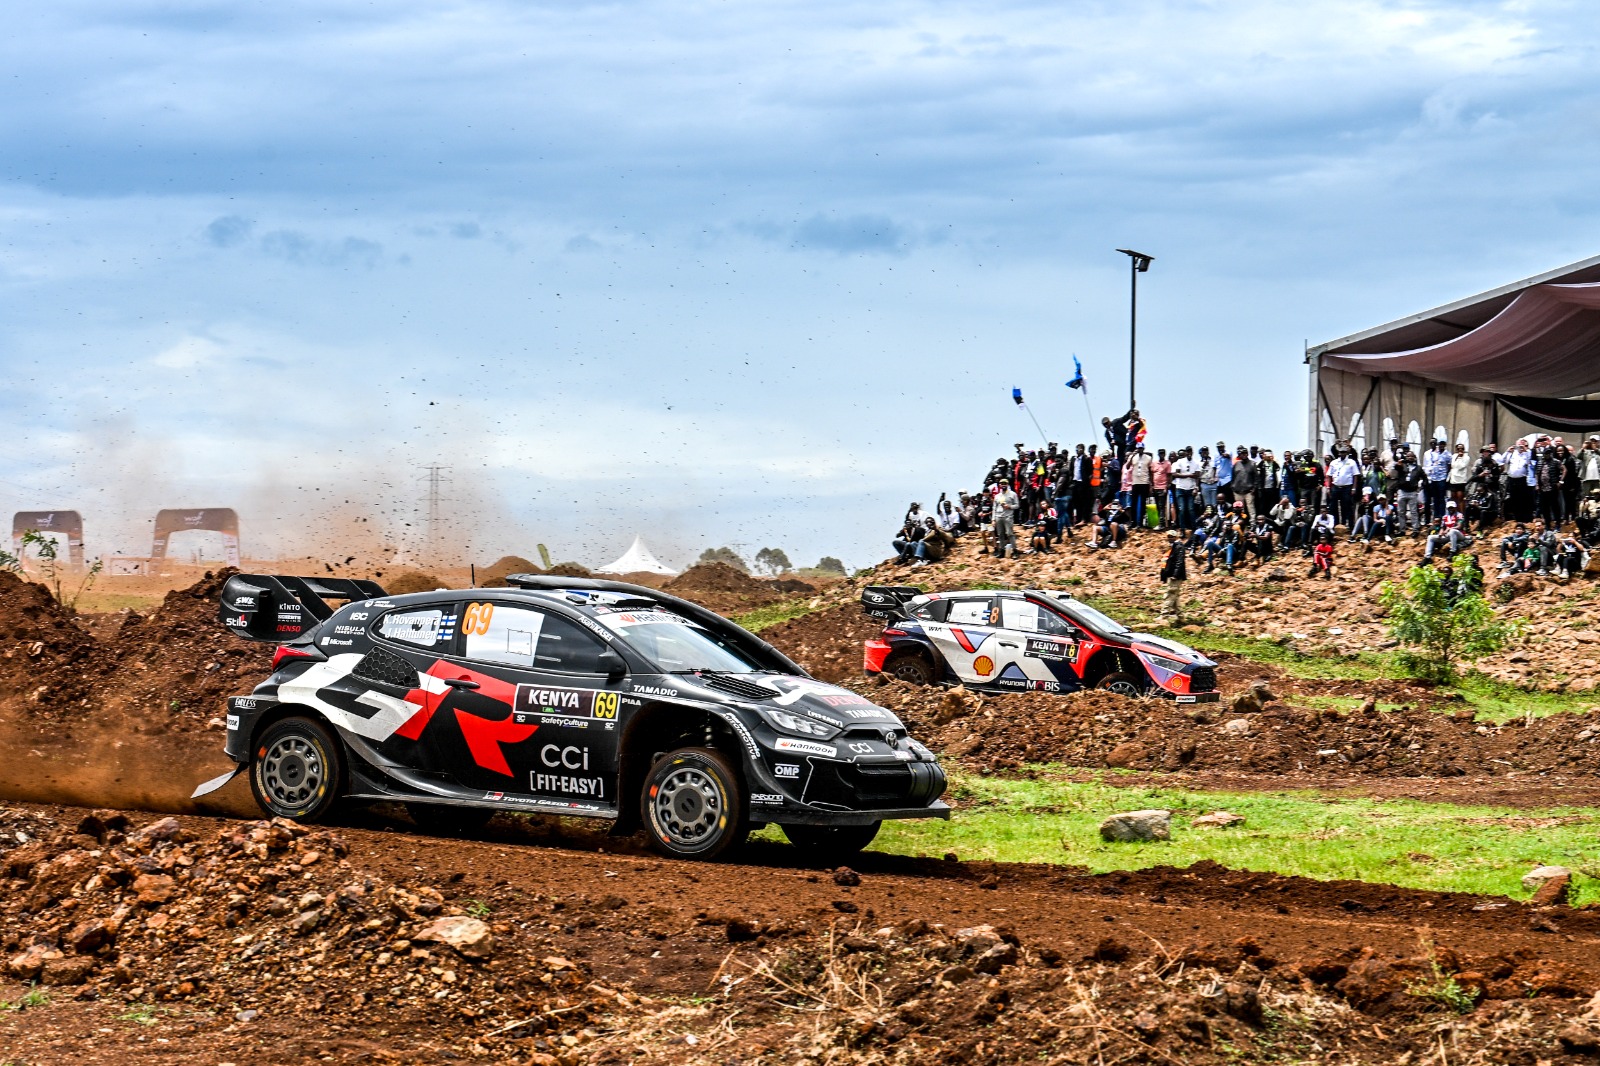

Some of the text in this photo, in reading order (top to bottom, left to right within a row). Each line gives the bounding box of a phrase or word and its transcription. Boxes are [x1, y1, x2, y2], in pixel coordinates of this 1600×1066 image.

[226, 614, 247, 627] Stilo
[462, 602, 493, 635] 69
[990, 607, 999, 623] 8
[1032, 641, 1059, 652] KENYA
[1068, 644, 1075, 657] 8
[633, 684, 678, 697] TAMADIC
[1026, 680, 1060, 692] MOBIS
[528, 689, 579, 708] KENYA
[621, 698, 641, 706] PIAA
[595, 692, 617, 719] 69
[541, 716, 589, 727] SafetyCulture
[774, 765, 800, 776] OMP
[502, 796, 537, 804] TOYOTA
